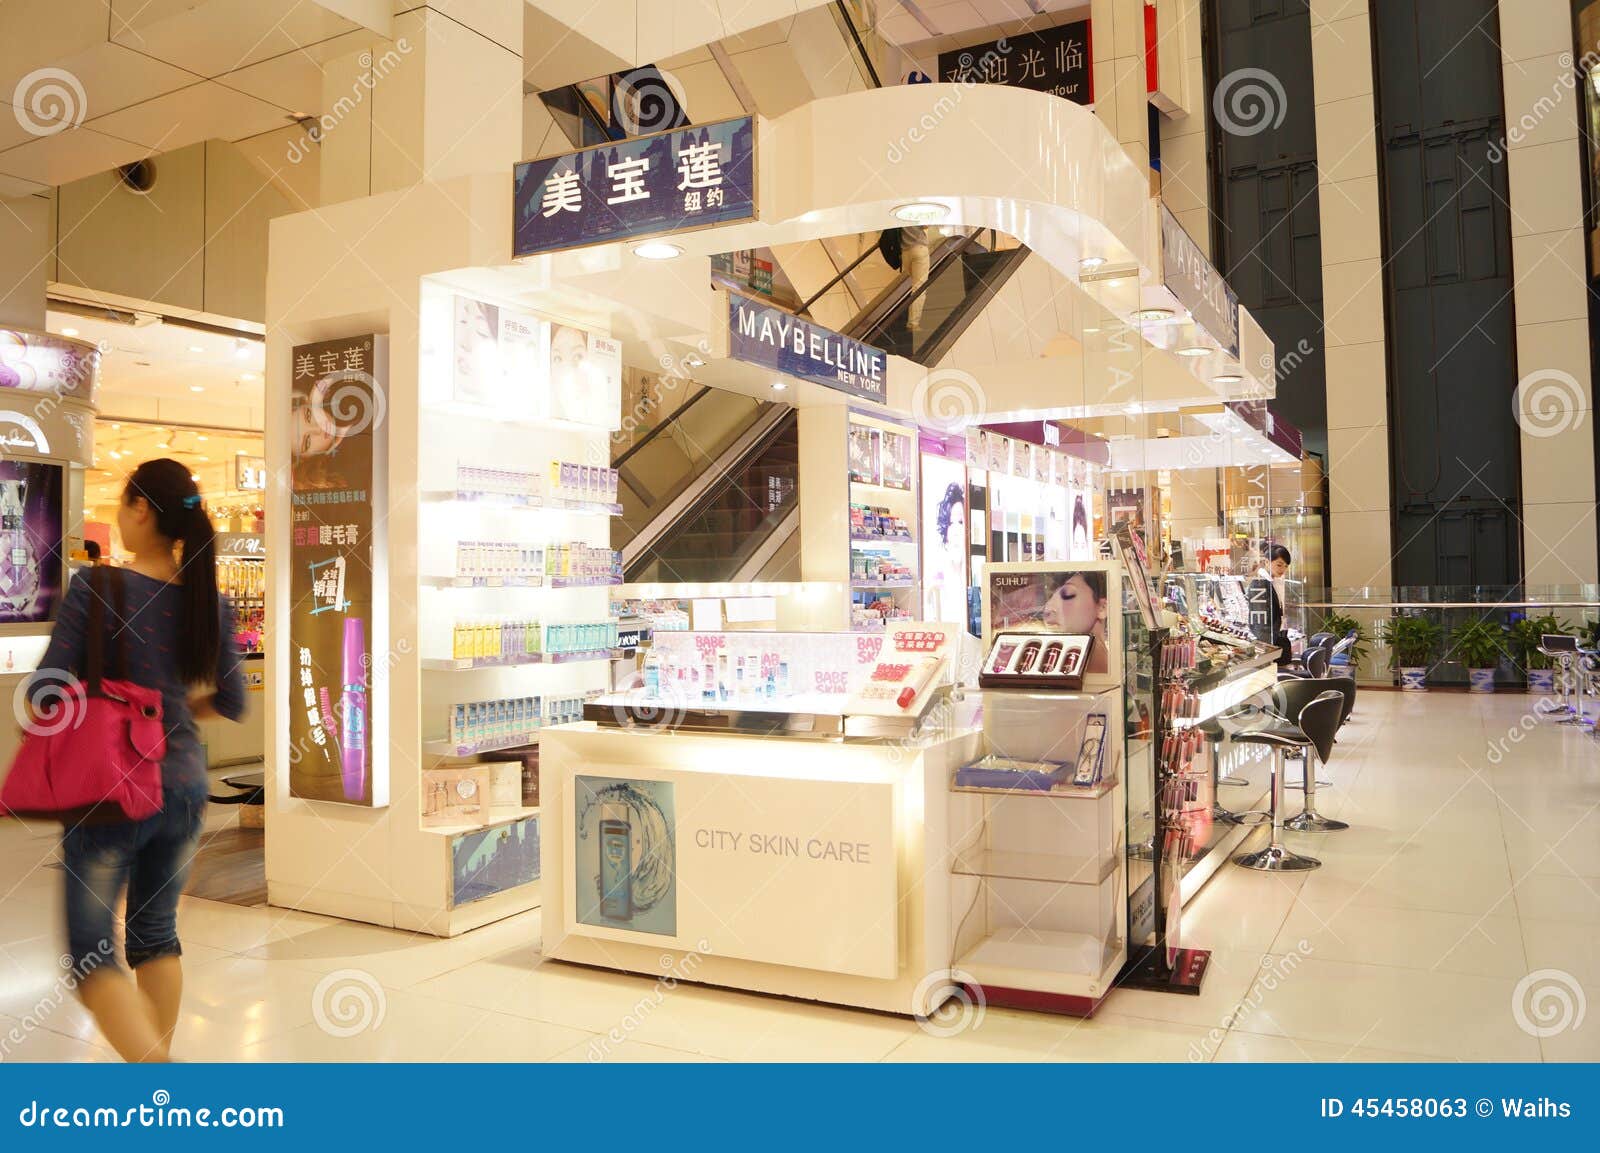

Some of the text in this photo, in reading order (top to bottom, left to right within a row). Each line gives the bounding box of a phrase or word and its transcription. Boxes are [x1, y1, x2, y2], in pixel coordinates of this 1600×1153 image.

[542, 142, 723, 217] 美宝莲
[683, 188, 724, 211] 纽约
[738, 305, 882, 381] MAYBELLINE
[295, 346, 364, 380] 美宝莲
[837, 368, 881, 393] NEW YORK
[313, 580, 338, 597] 销量
[695, 635, 726, 648] BABE
[857, 636, 883, 651] BAB
[814, 671, 848, 684] BABE
[815, 683, 848, 694] SKIN
[694, 828, 871, 864] CITY SKIN CARE
